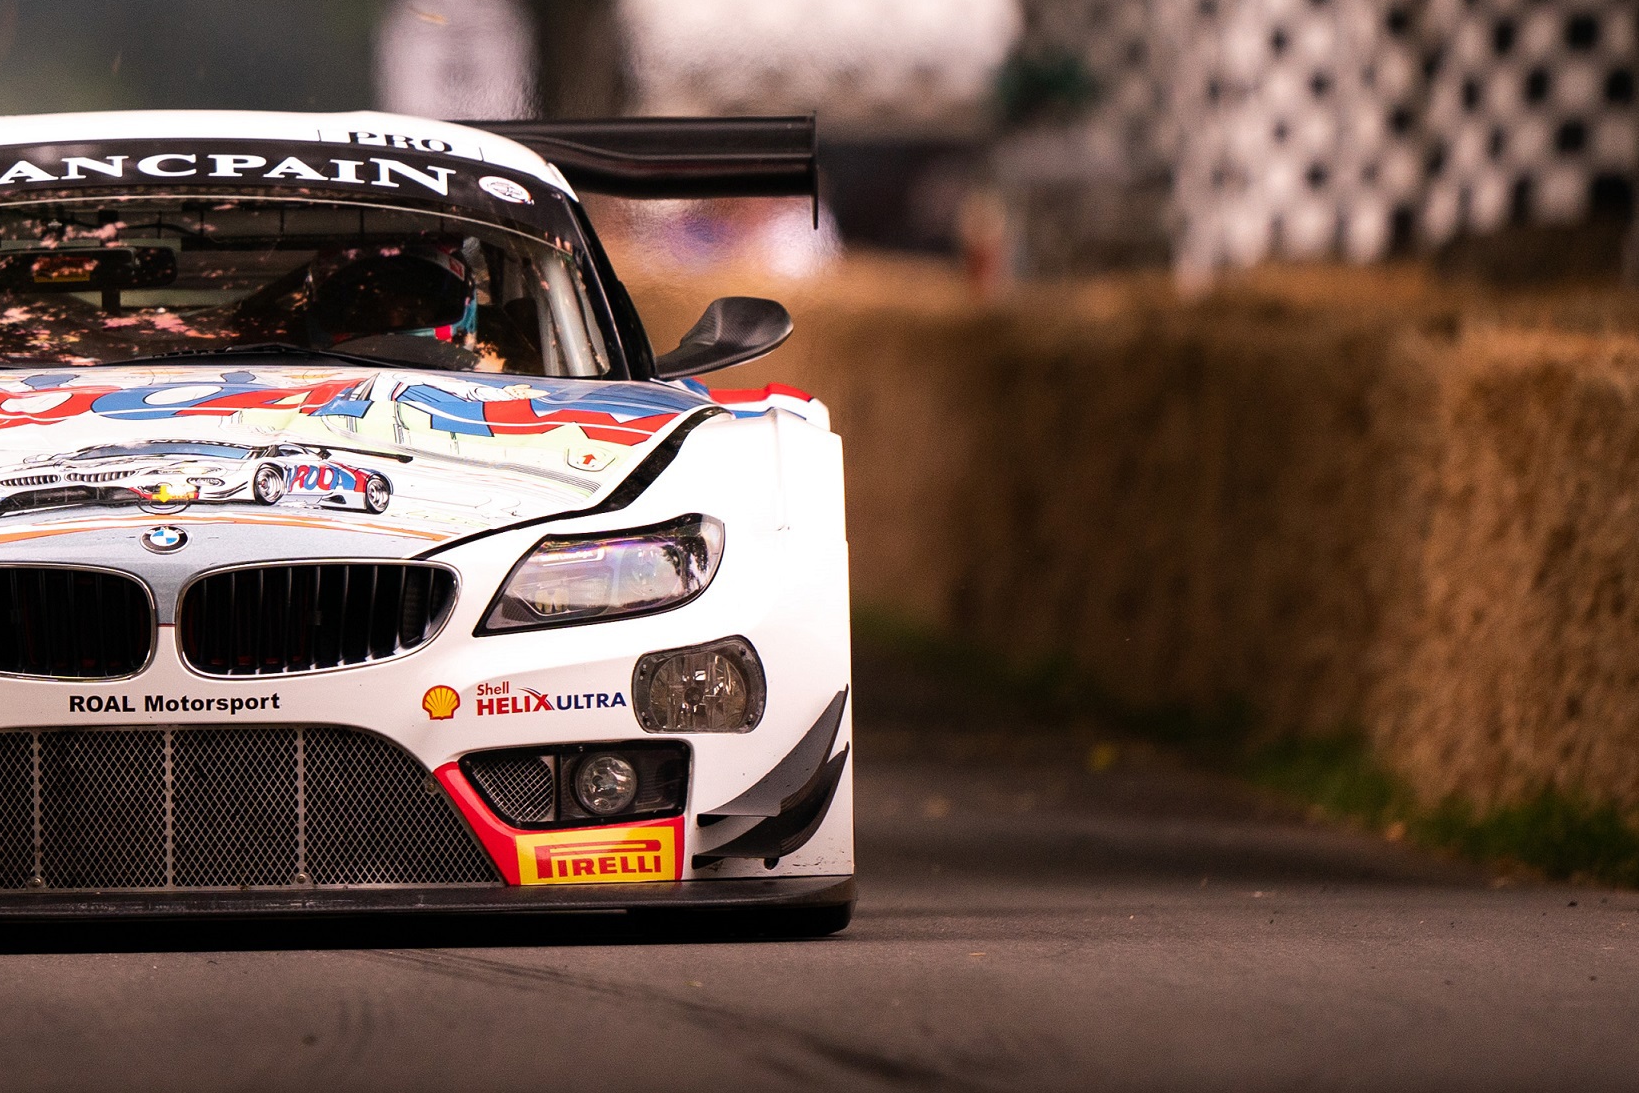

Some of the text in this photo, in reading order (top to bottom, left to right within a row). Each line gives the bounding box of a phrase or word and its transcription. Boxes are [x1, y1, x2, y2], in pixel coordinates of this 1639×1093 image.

[348, 131, 453, 153] PRO
[477, 681, 510, 696] Shell
[69, 692, 281, 715] ROAL Motorsport
[476, 687, 627, 716] HELIX ULTRA
[534, 839, 662, 880] PIRELLI
